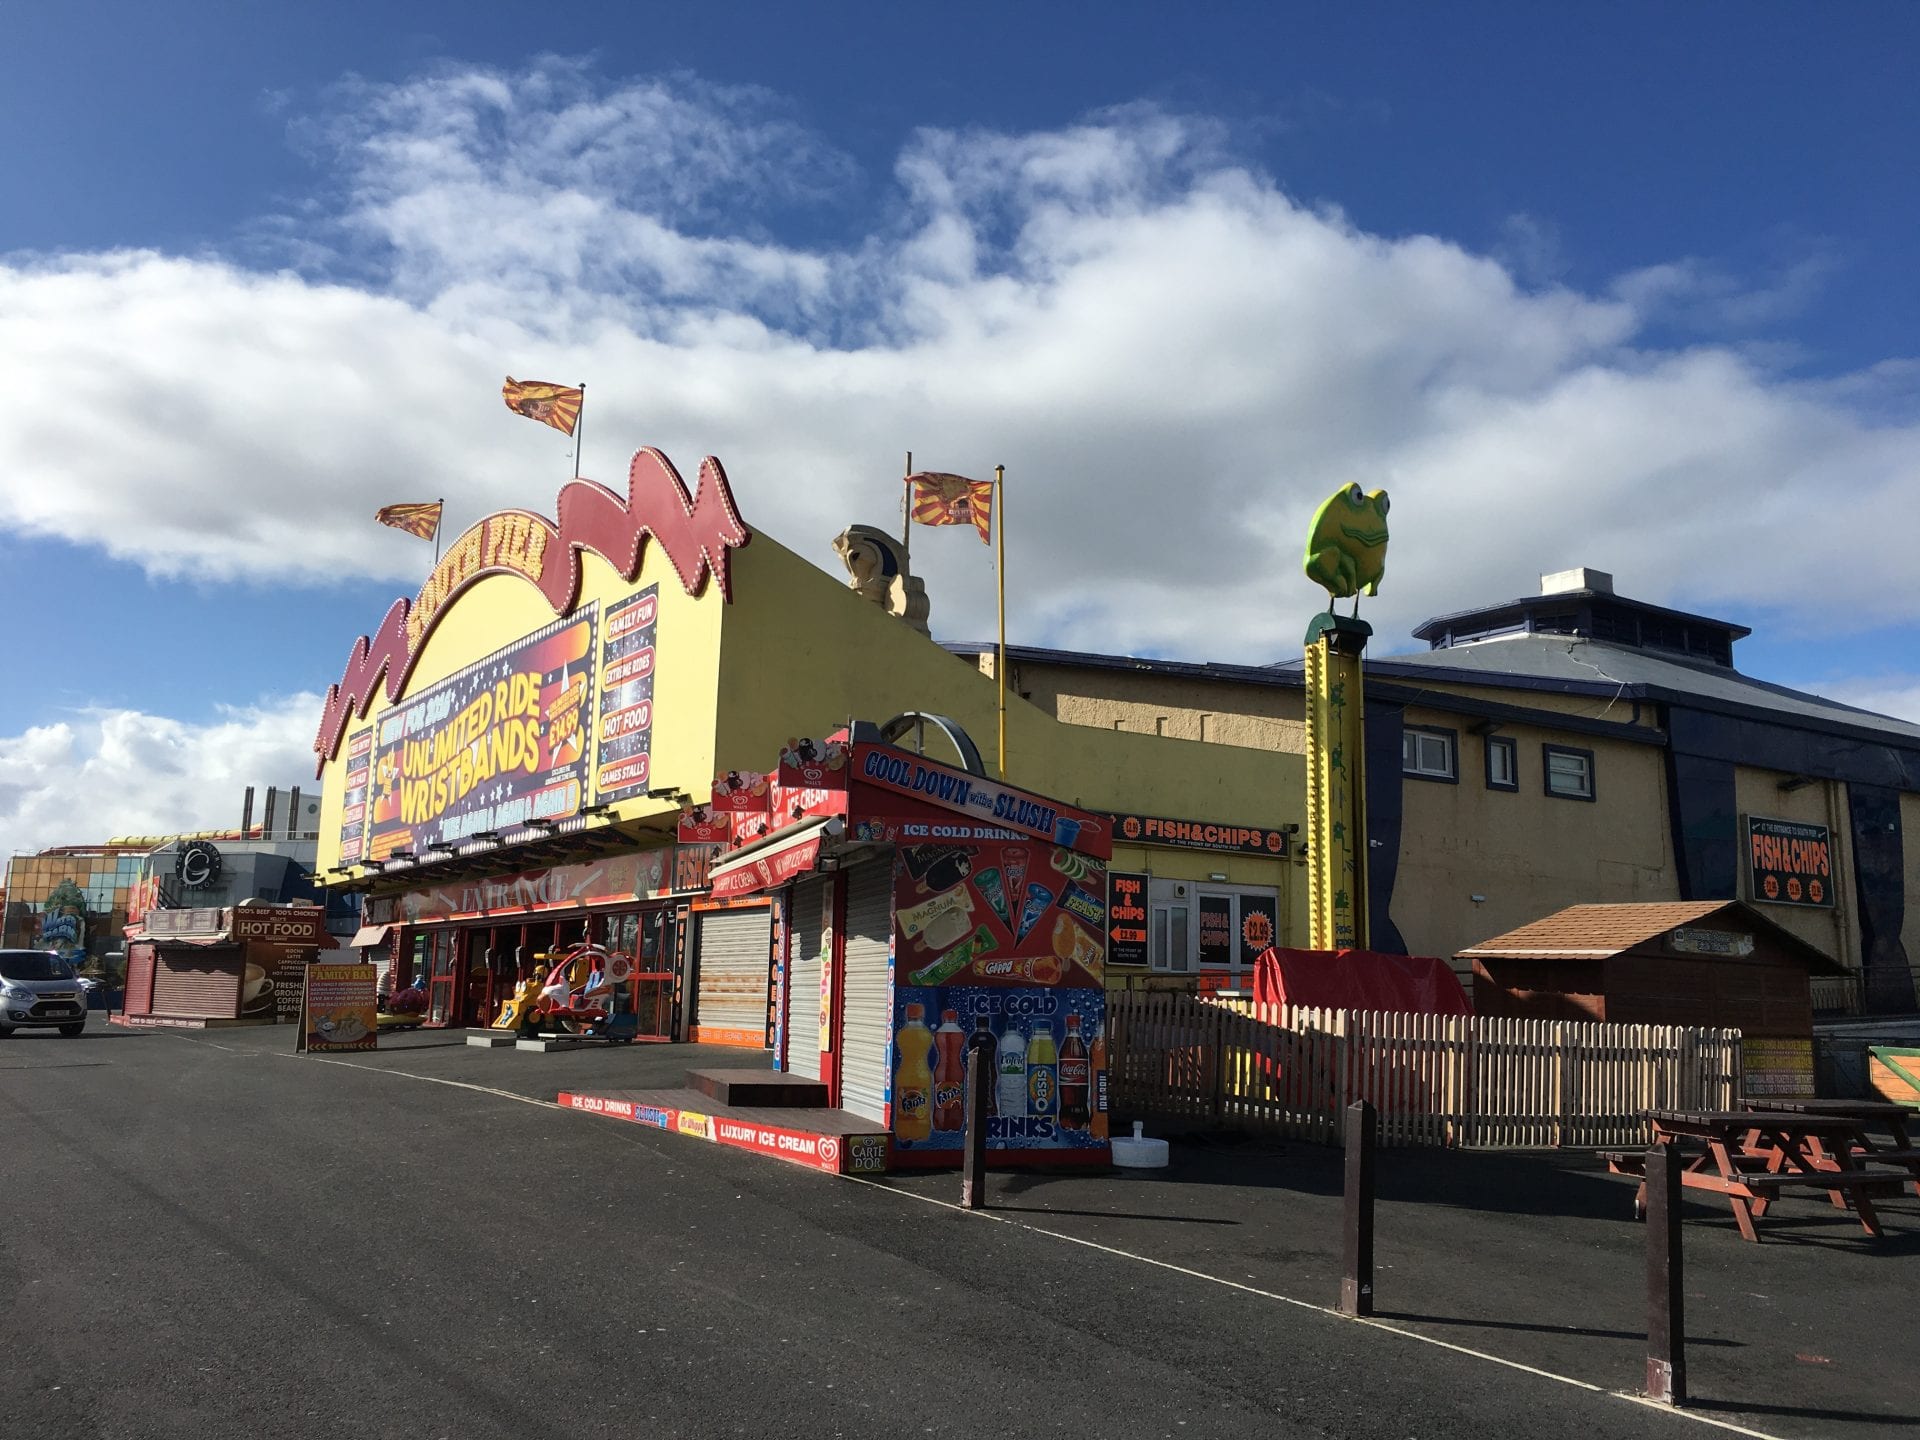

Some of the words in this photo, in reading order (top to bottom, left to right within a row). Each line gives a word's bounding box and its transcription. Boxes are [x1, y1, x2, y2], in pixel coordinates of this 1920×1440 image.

[406, 521, 484, 656] SOUTH
[484, 513, 547, 581] PIER
[608, 608, 637, 637] FAMILY
[637, 602, 653, 623] FUN
[605, 662, 632, 685] EXTREME
[632, 655, 649, 675] RIDES
[402, 691, 493, 778] UNLIMITED
[494, 671, 543, 724] RIDE
[603, 714, 622, 738] HOT
[622, 705, 649, 730] FOOD
[400, 717, 541, 825] WRISTBANDS
[600, 767, 621, 786] GAMES
[621, 760, 645, 781] STALLS
[787, 795, 801, 819] ICE
[800, 788, 829, 810] CREAM
[864, 750, 910, 787] COOL
[912, 766, 972, 807] DOWN
[992, 792, 1057, 834] SLUSH
[736, 824, 746, 840] ICE
[745, 813, 768, 837] CREAM
[904, 824, 929, 836] ICE
[931, 825, 972, 838] COLD
[974, 826, 1030, 841] DRINKS
[1145, 818, 1262, 847] FISH&CHIPS
[463, 871, 569, 912] ENTRANCE
[1115, 879, 1141, 894] FISH
[912, 897, 956, 921] MAGNUM
[1124, 893, 1132, 907] &
[1111, 906, 1145, 921] CHIPS
[240, 922, 271, 934] HOT
[273, 924, 313, 936] FOOD
[1120, 930, 1138, 940] £2.99
[1200, 930, 1230, 946] CHIPS
[309, 971, 351, 980] FAMILY
[352, 971, 375, 980] BAR
[769, 902, 781, 1045] BURGERS
[967, 994, 1000, 1014] ICE
[1004, 995, 1058, 1015] COLD
[571, 1095, 584, 1109] ICE
[584, 1097, 604, 1111] COLD
[604, 1099, 632, 1115] DRINKS
[635, 1105, 661, 1123] SLUSH
[720, 1124, 756, 1143] LUXURY
[758, 1132, 776, 1147] ICE
[778, 1135, 815, 1155] CREAM
[984, 1116, 1054, 1139] RINKS
[851, 1145, 884, 1158] CARTE
[855, 1157, 881, 1170] D'OR
